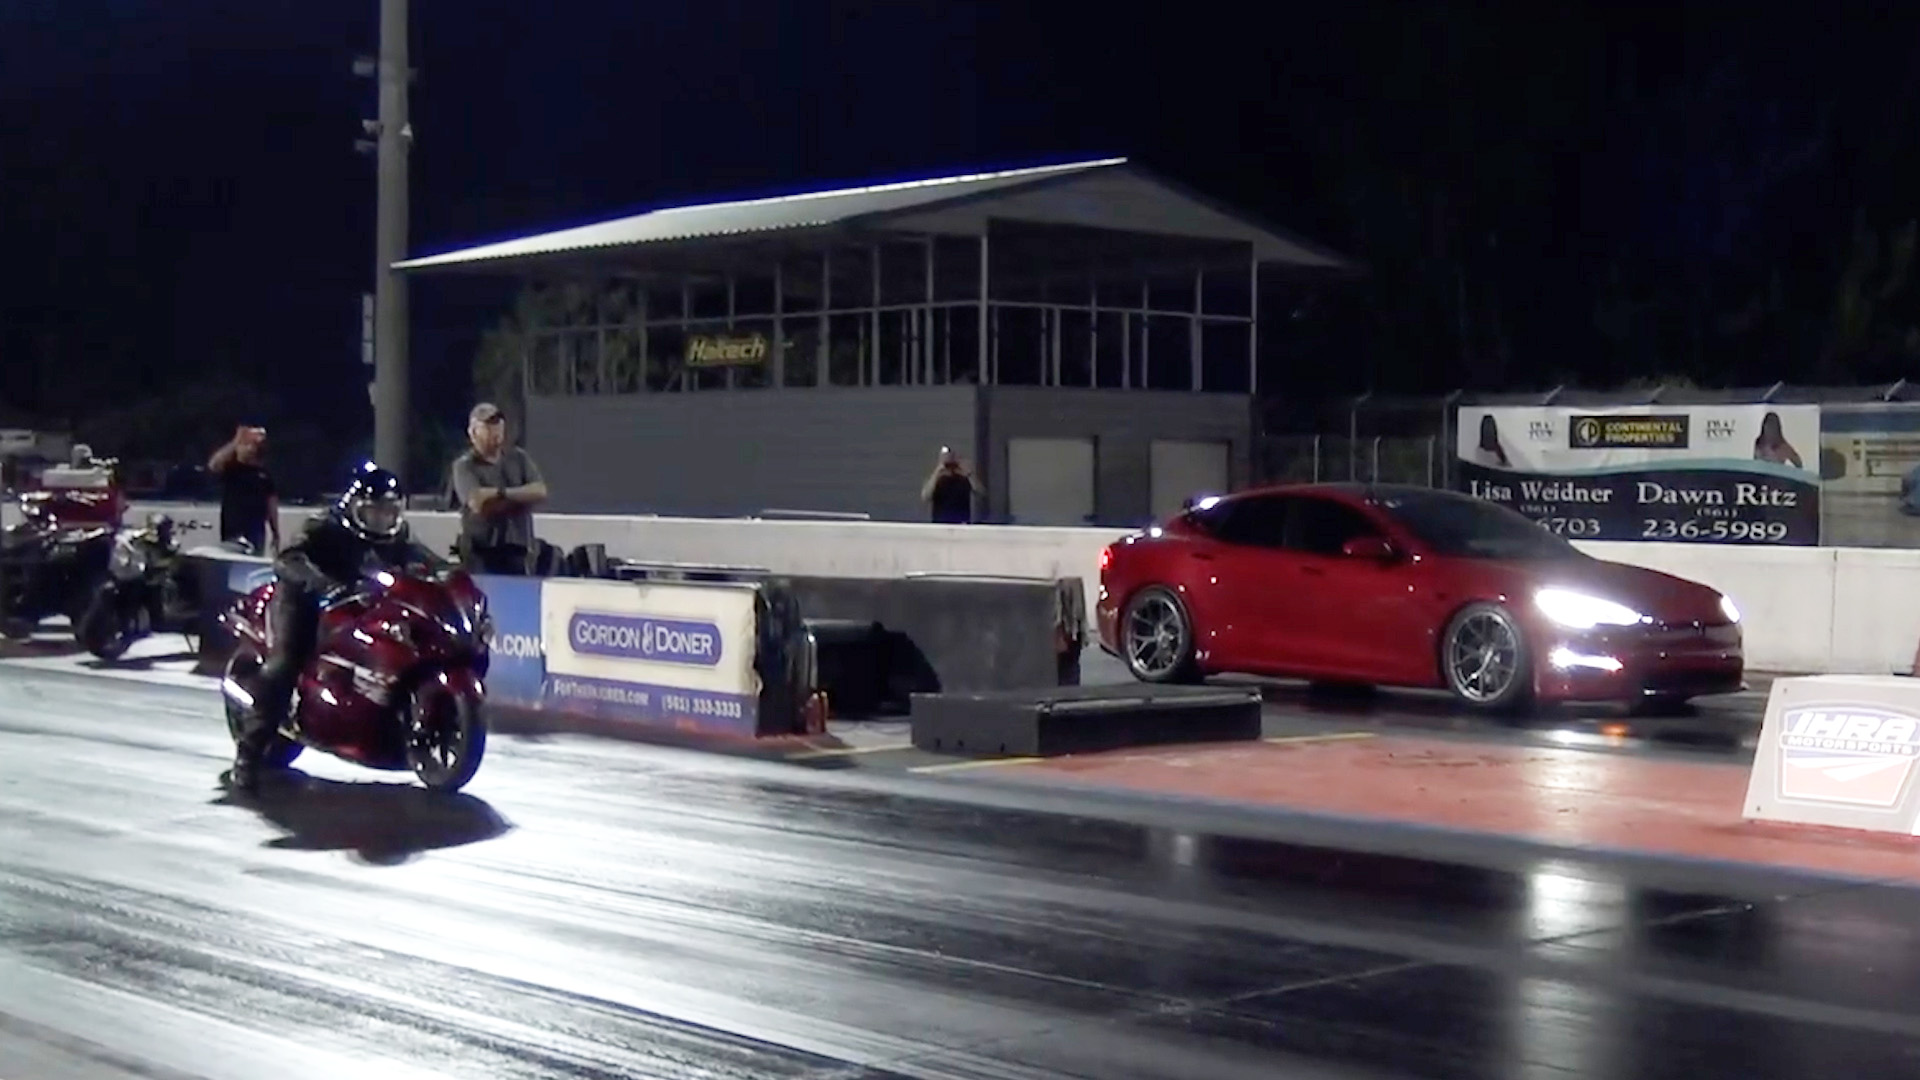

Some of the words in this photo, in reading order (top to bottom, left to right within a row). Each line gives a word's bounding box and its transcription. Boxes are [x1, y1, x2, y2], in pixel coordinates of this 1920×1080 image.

[1604, 421, 1684, 434] CONTINENTAL
[1604, 432, 1676, 443] PROPERTIES
[1470, 480, 1512, 502] Lisa
[1520, 480, 1613, 503] Weidner
[1637, 482, 1724, 506] Dawn
[1736, 483, 1797, 508] Ritz
[1696, 508, 1738, 518] (561)
[1641, 518, 1788, 541] 236-5989
[575, 620, 641, 650] GORDON
[655, 626, 713, 656] DONER
[661, 694, 690, 713] (561)
[692, 698, 742, 718] 333-3333
[1790, 711, 1917, 743] IHRA
[1787, 735, 1914, 756] MOTORSPORTS
